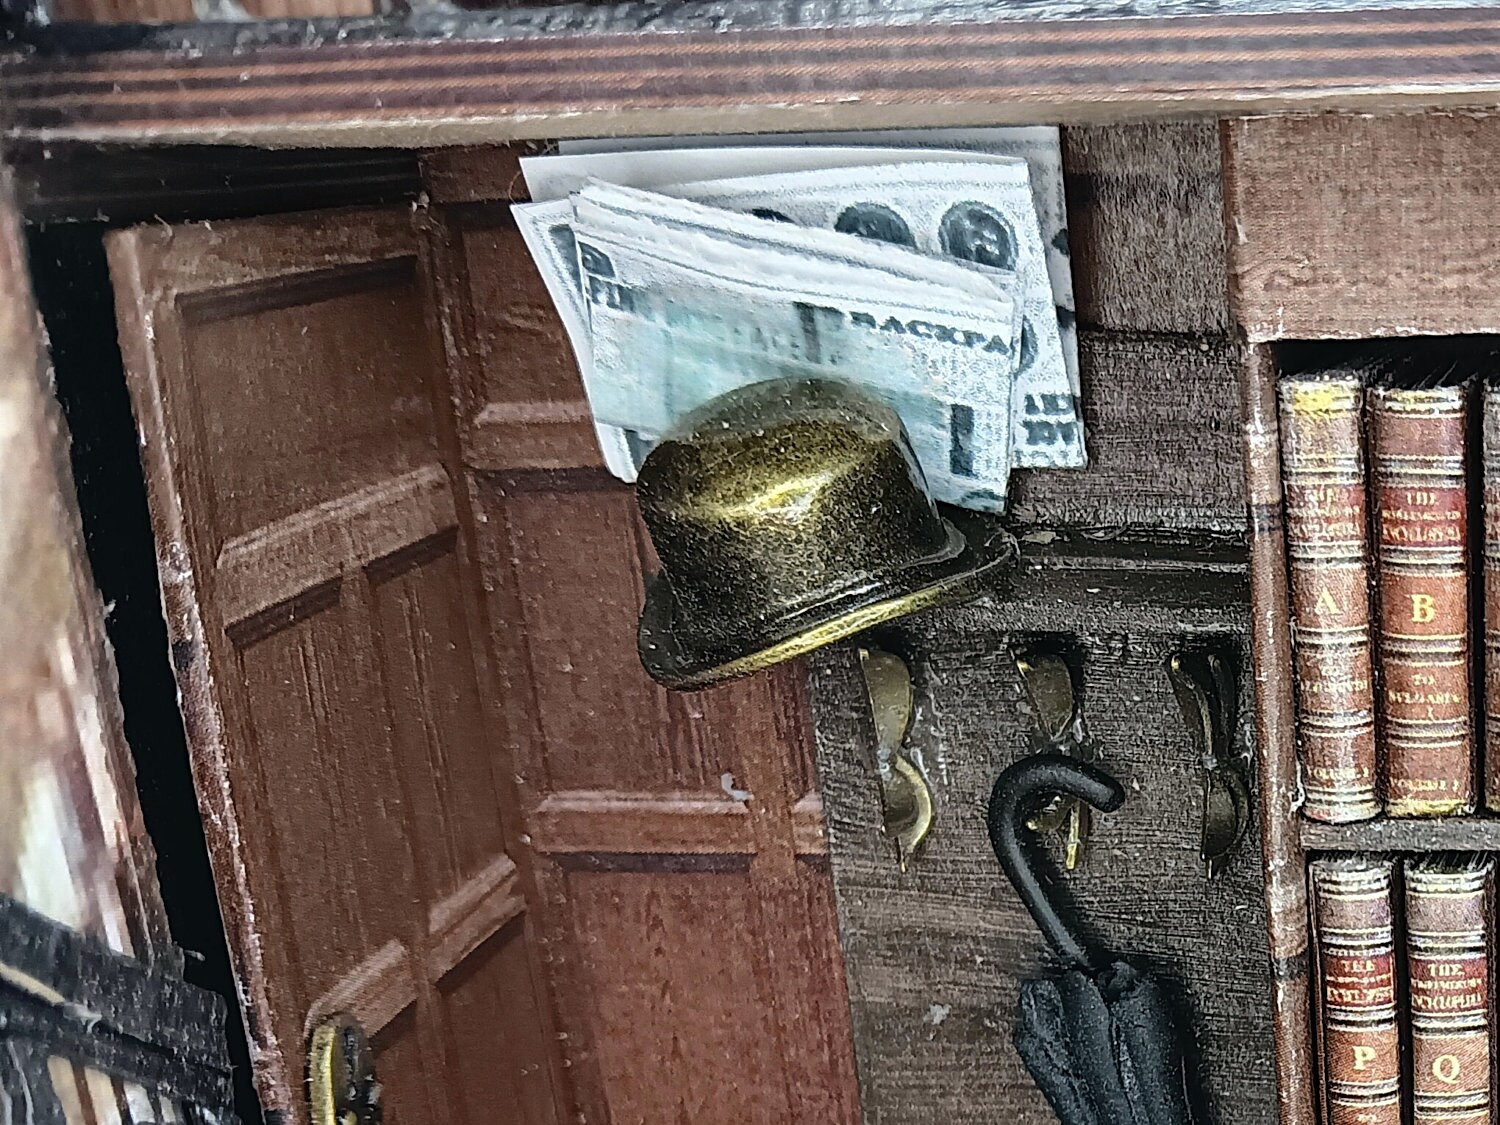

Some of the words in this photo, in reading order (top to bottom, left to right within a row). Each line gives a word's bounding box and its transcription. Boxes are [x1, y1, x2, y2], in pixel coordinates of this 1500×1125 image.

[1314, 590, 1340, 614] A
[1408, 594, 1436, 622] B
[1428, 964, 1465, 977] THE
[1353, 1046, 1376, 1070] P
[1432, 1054, 1461, 1084] Q
